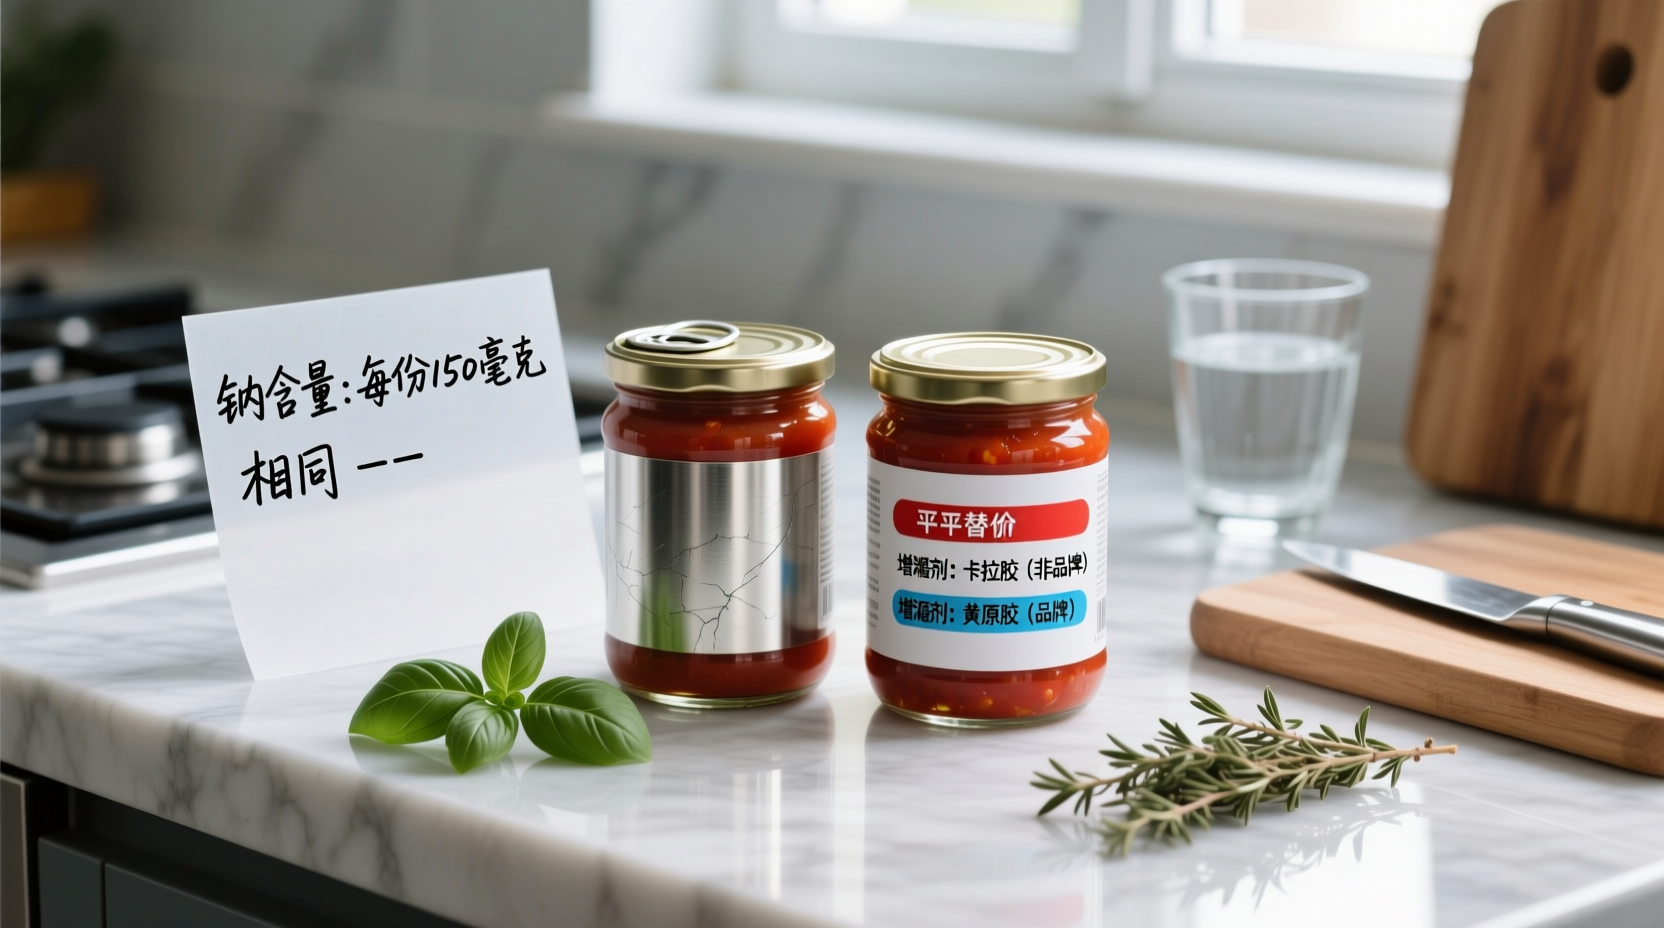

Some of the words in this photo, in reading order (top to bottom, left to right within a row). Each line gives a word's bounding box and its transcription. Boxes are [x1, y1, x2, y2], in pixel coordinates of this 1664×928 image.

[241, 443, 339, 506] 相同
[916, 508, 1016, 539] 平平替价
